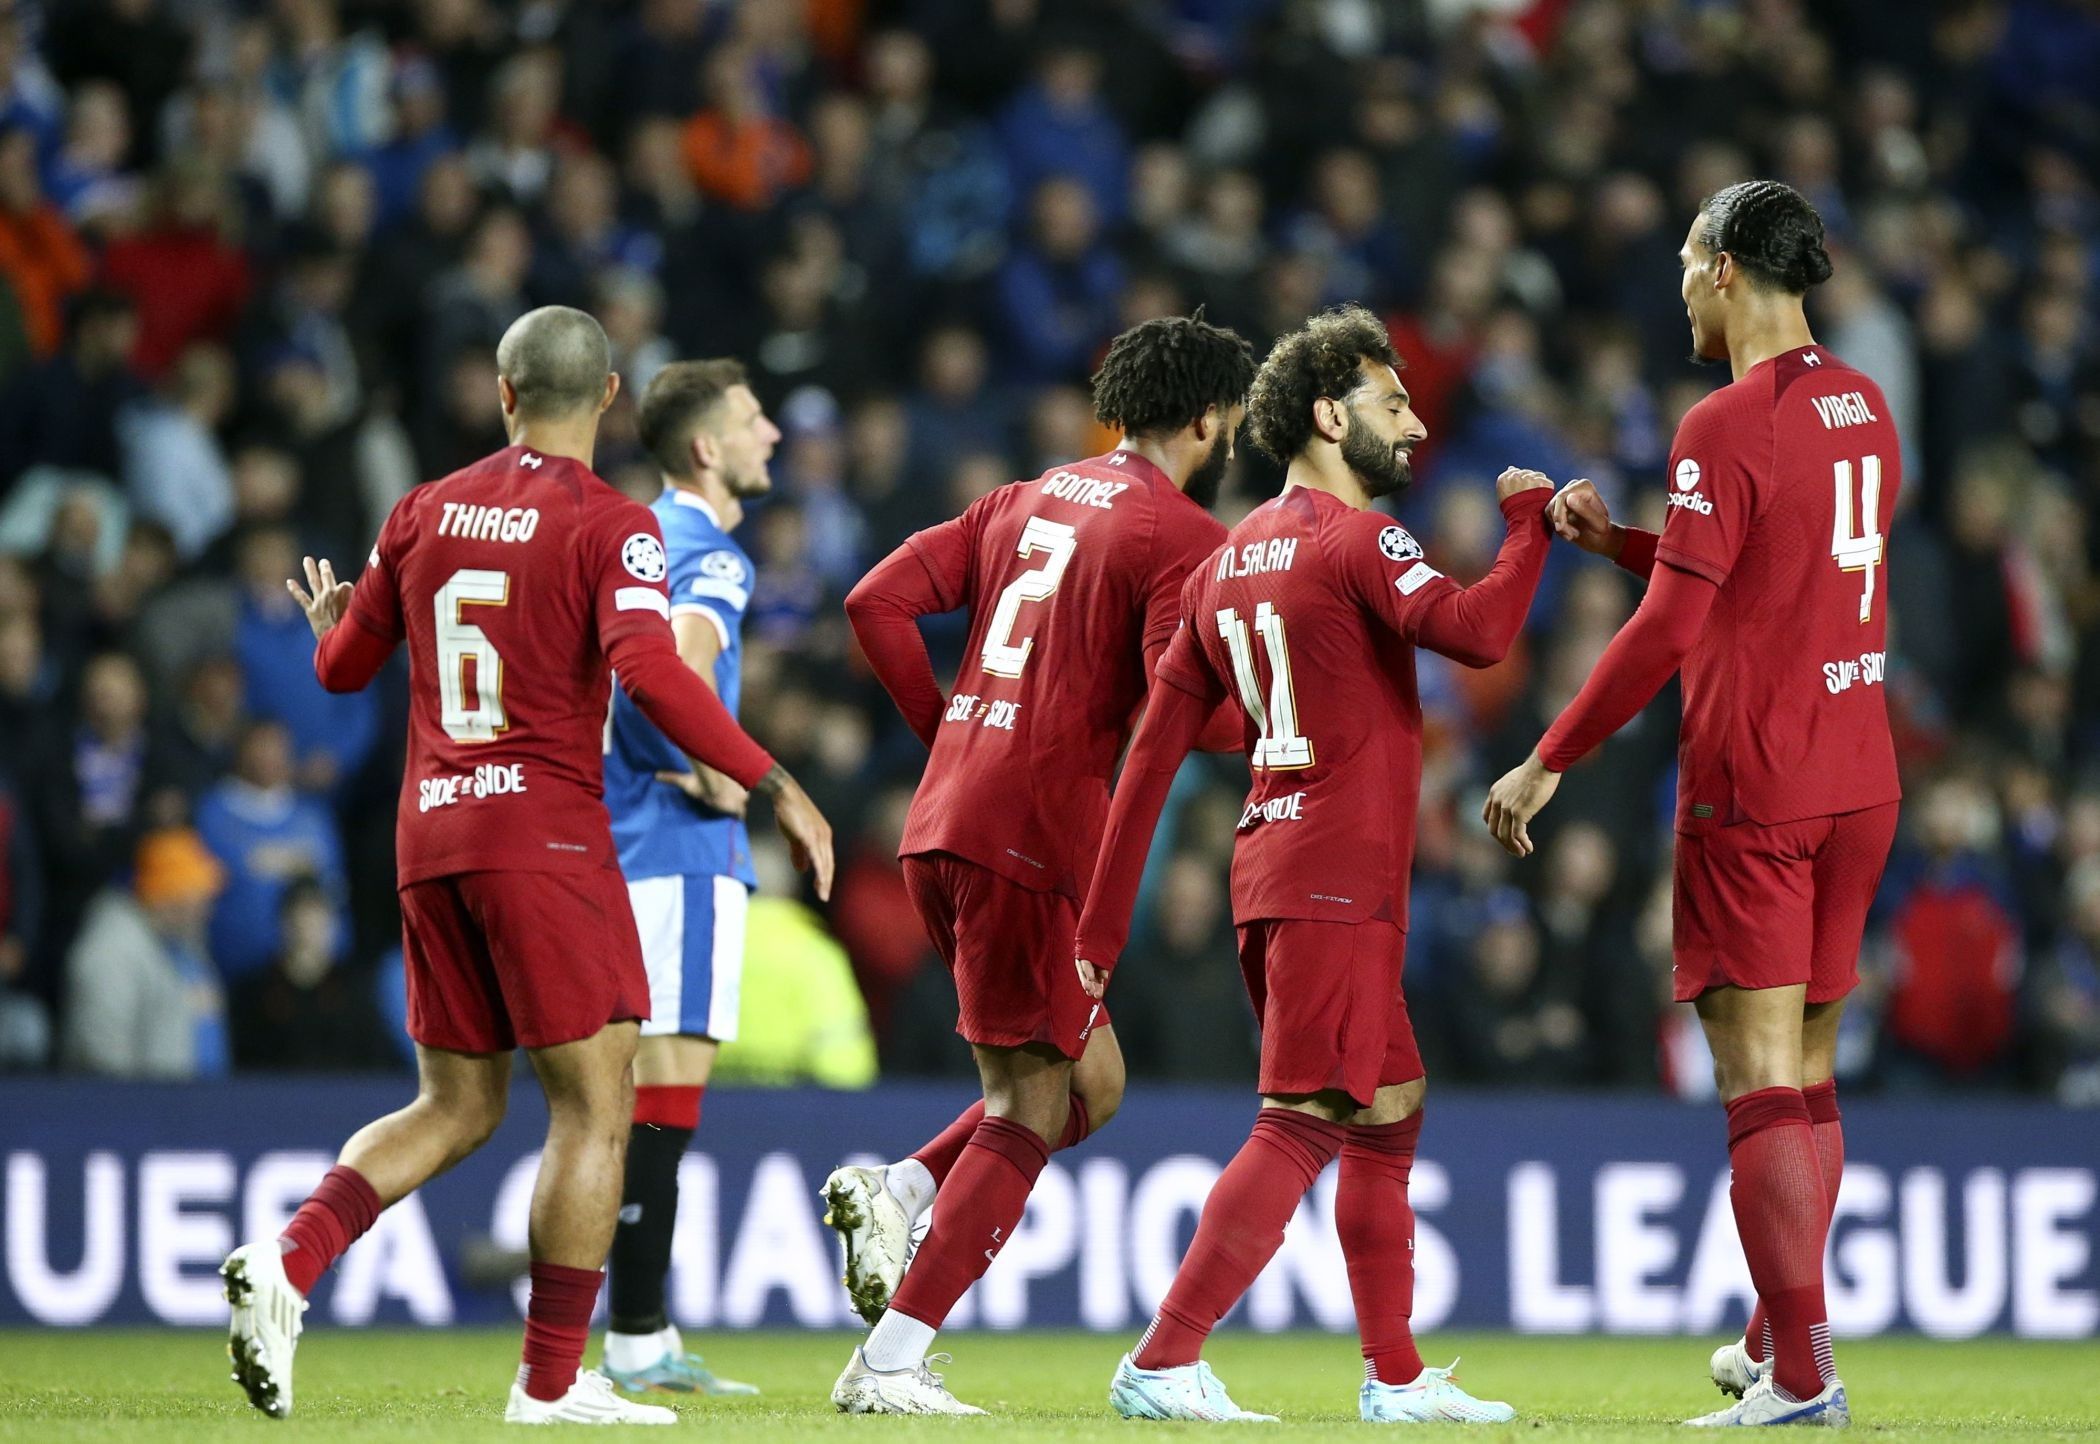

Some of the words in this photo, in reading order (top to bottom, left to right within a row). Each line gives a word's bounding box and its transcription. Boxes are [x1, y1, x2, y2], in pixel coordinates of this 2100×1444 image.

[1811, 391, 1877, 429] VIRGIL
[438, 503, 540, 542] THIAGO
[1667, 491, 1713, 516] xpedia
[1831, 455, 1883, 625] 4
[980, 515, 1078, 680] 2
[434, 569, 510, 742] 6
[1859, 651, 1886, 686] SID
[1216, 601, 1315, 772] 11
[983, 699, 1022, 730] SIDE
[419, 775, 463, 813] SIDE
[473, 763, 528, 799] SIDE
[6, 1149, 455, 1328] UEFA
[491, 1149, 1461, 1336] APIONS
[1506, 1159, 2098, 1341] LEAGUE
